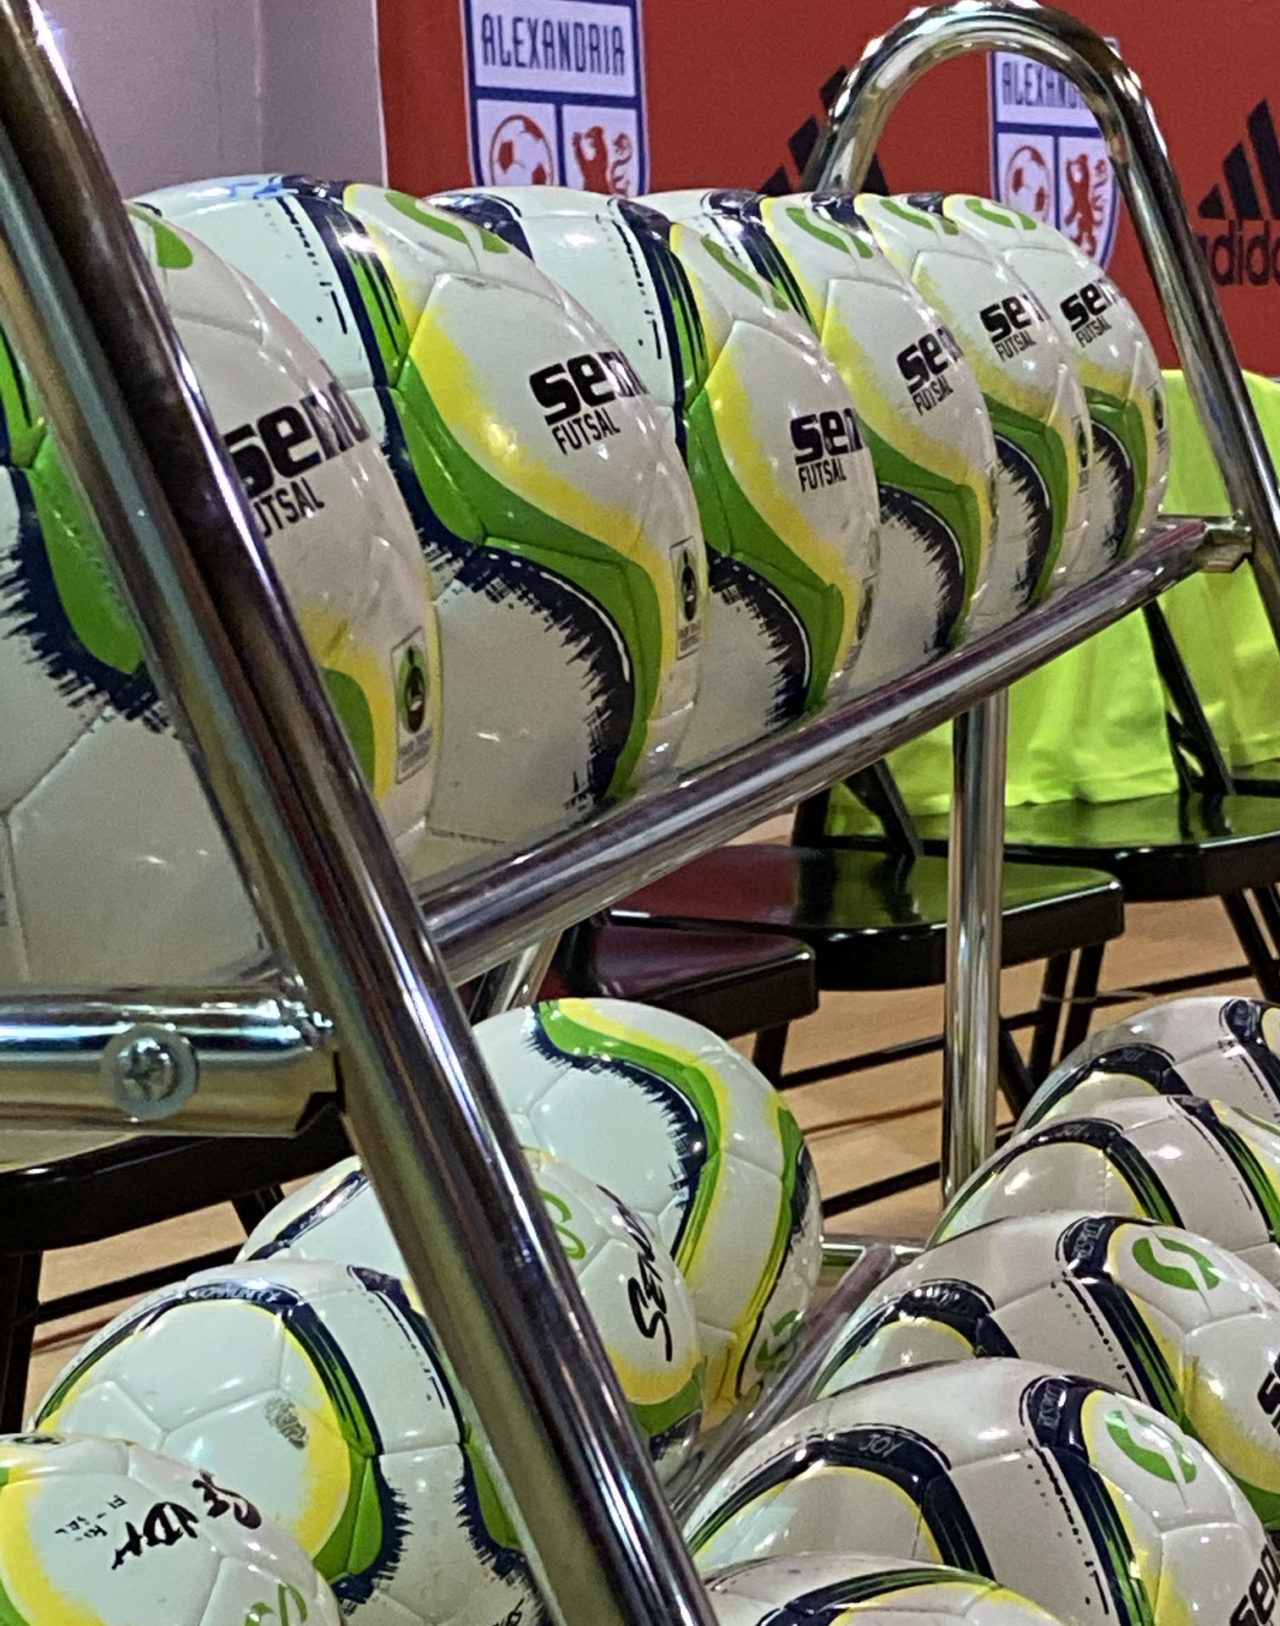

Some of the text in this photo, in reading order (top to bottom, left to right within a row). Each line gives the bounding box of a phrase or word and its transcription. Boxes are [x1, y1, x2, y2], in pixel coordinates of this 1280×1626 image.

[481, 13, 625, 76] ALEXANDRIA
[994, 331, 1036, 362] FUTSAL
[1075, 315, 1112, 348] FUTSAL
[551, 407, 621, 455] FUTSAL
[798, 457, 847, 492] FUTSAL
